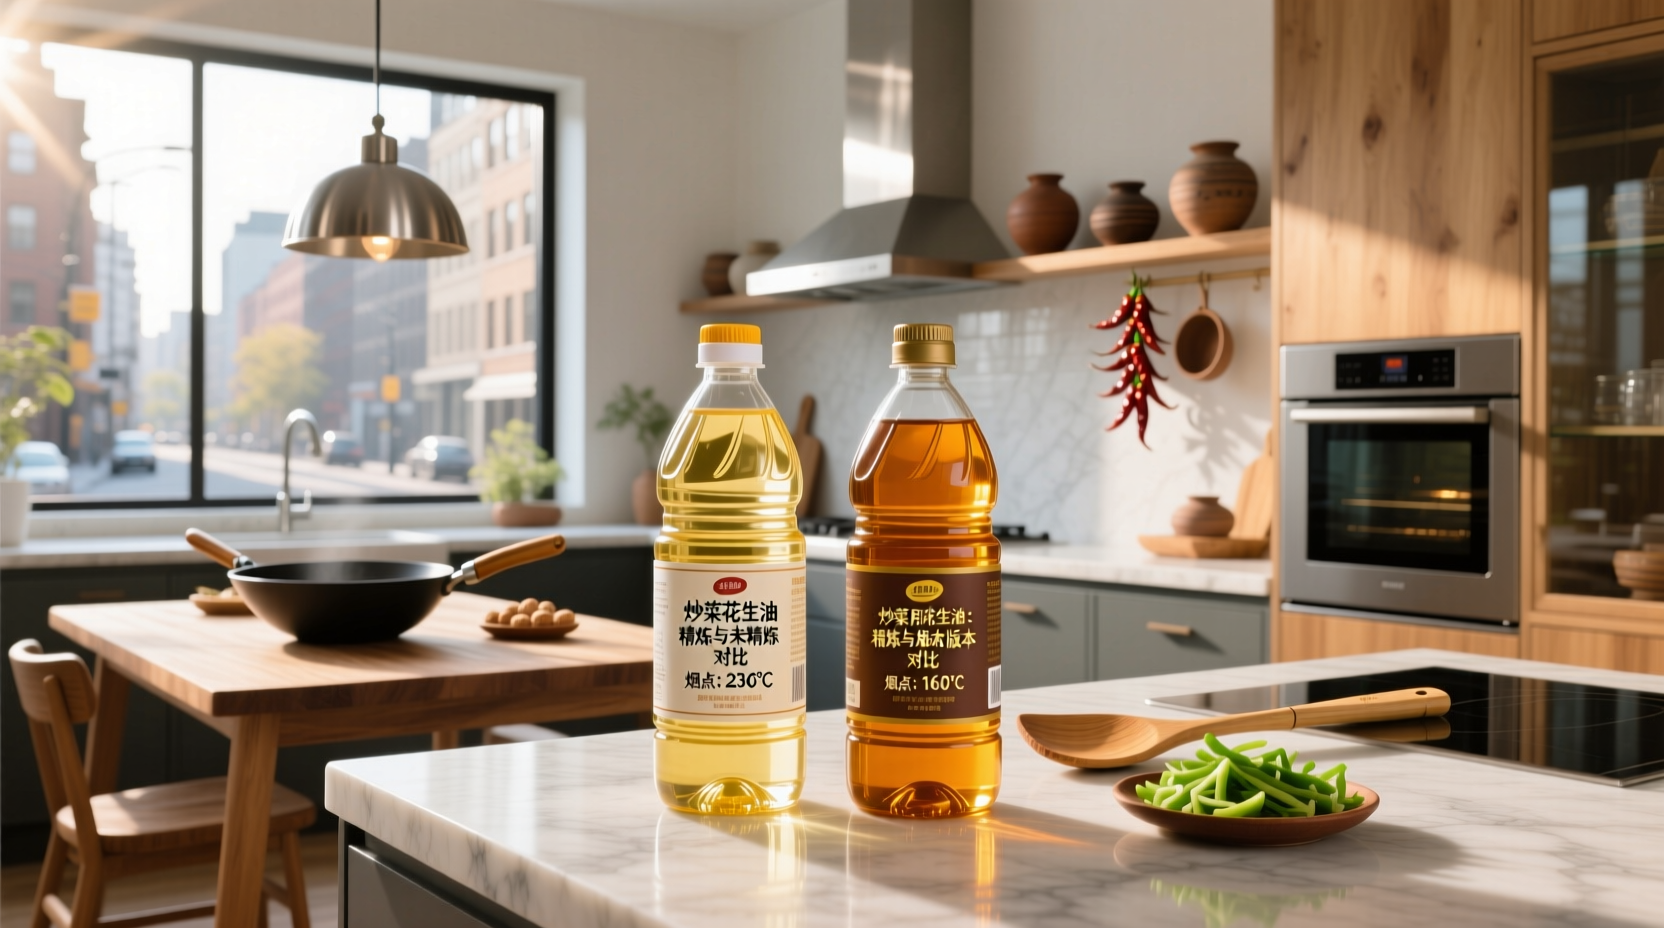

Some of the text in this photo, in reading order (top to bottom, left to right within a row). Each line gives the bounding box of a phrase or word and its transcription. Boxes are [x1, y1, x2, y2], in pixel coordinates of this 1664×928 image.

[684, 599, 778, 623] 炒菜花生油
[713, 647, 748, 667] 对比
[907, 649, 940, 669] 对比
